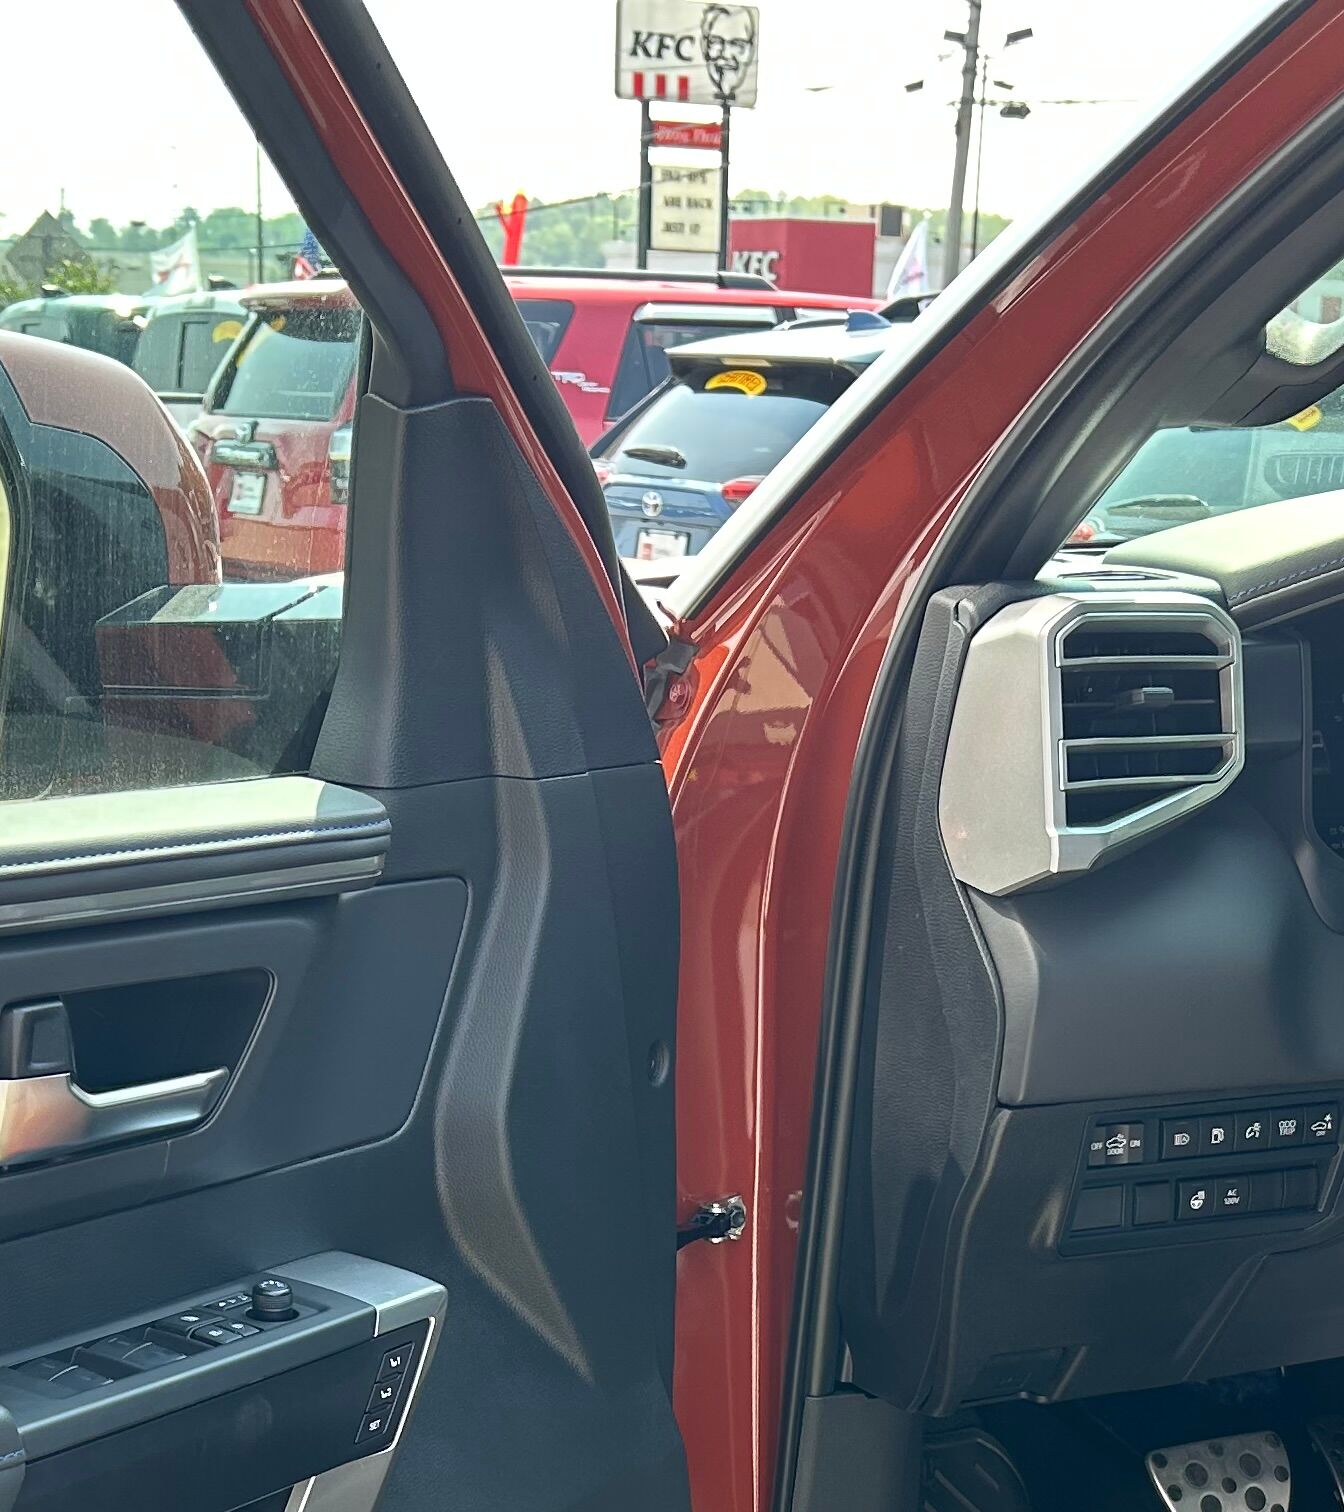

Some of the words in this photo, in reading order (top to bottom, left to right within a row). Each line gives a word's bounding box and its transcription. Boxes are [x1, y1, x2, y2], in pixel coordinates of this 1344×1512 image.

[630, 30, 696, 62] KFC
[732, 250, 780, 281] KFC
[369, 1419, 381, 1431] SET
